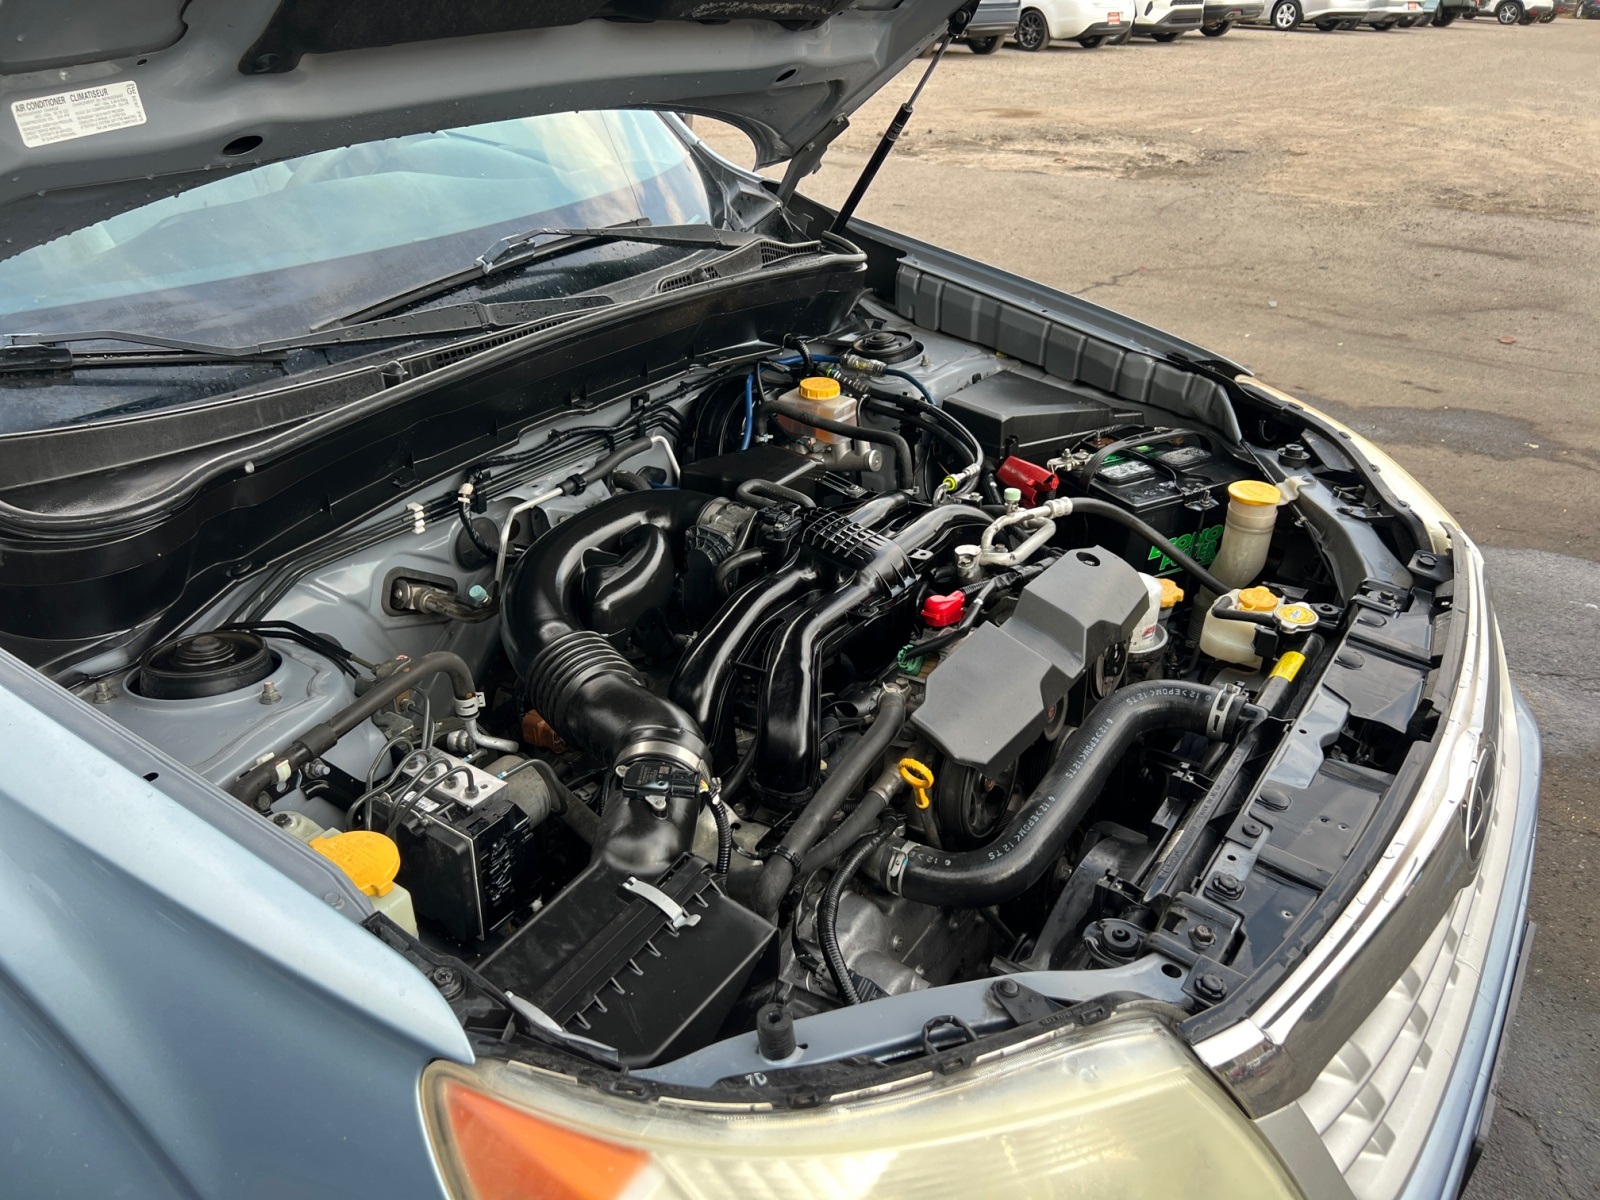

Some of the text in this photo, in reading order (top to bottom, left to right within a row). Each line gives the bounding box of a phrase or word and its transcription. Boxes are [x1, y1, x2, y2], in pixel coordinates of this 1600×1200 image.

[15, 88, 108, 113] AIR CONDITIONER CLIMATISEUR
[126, 86, 136, 95] GE
[1148, 524, 1224, 560] EONO
